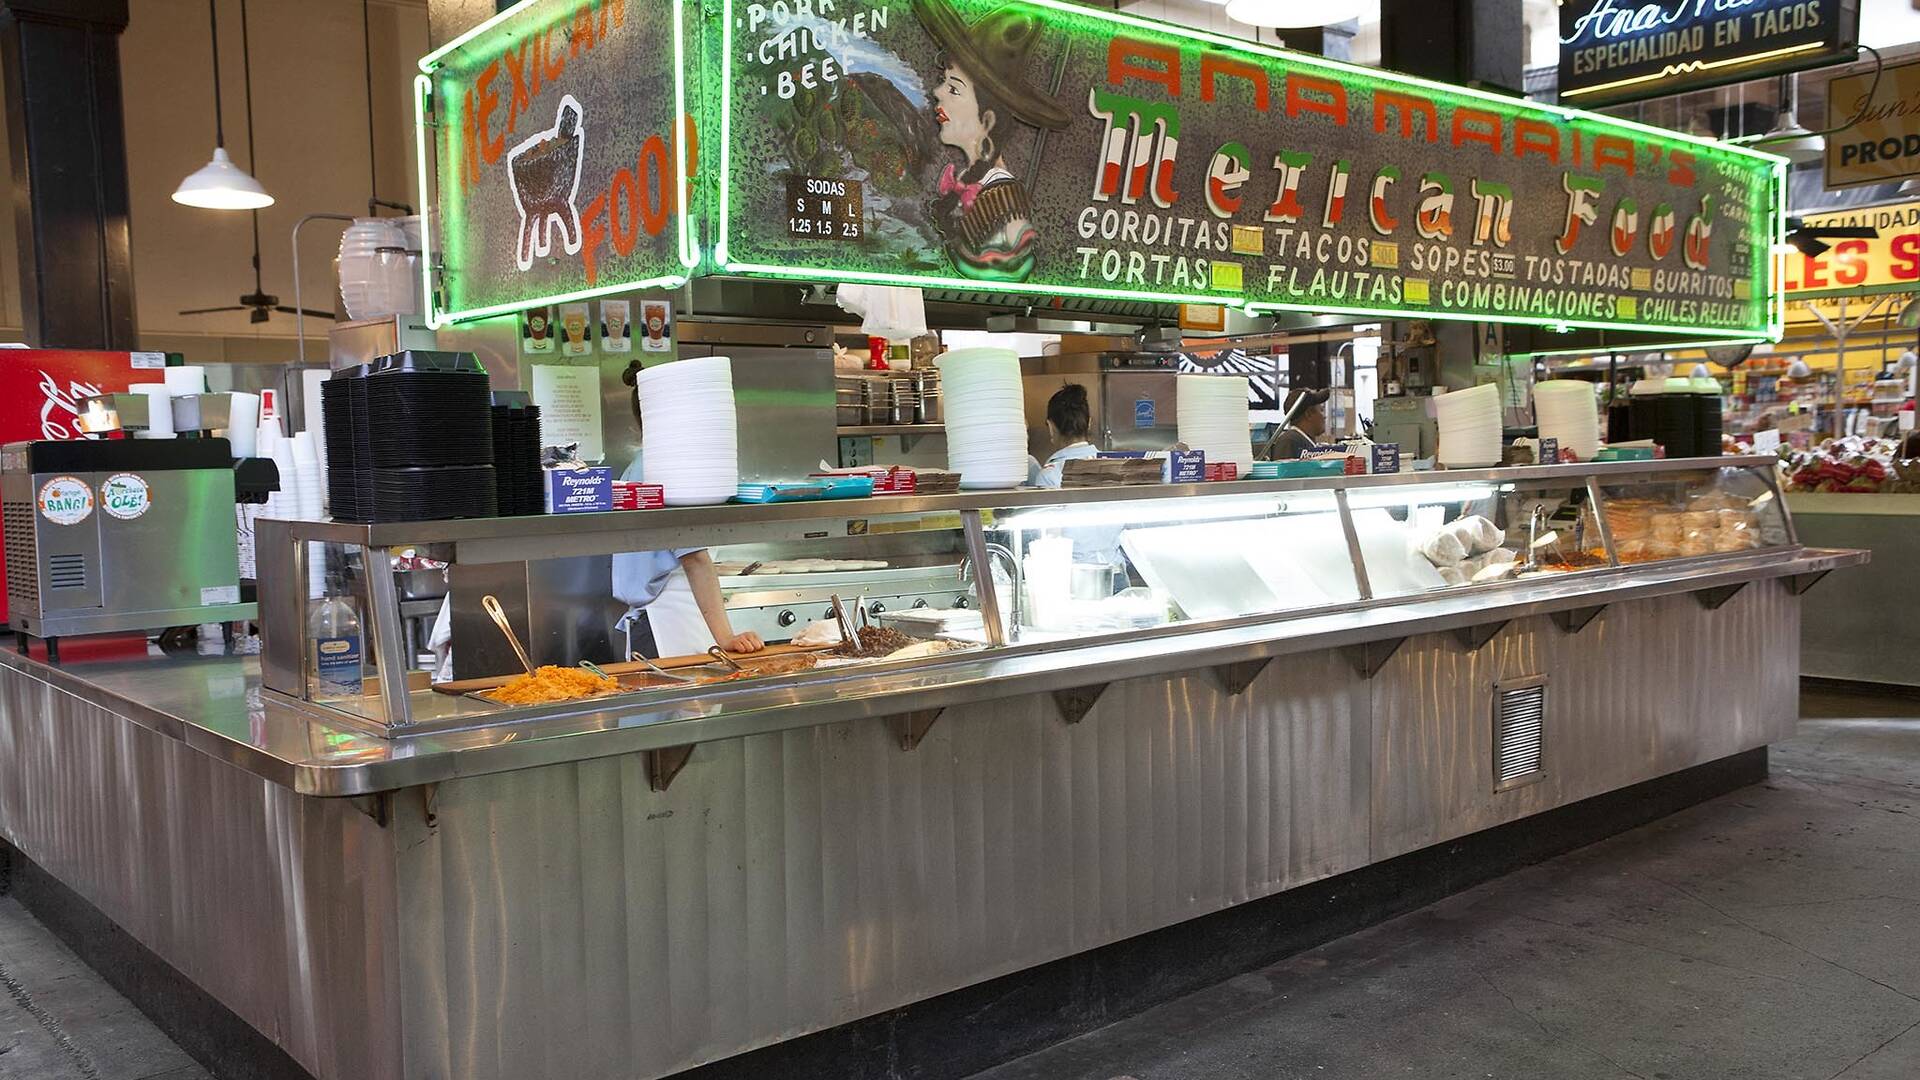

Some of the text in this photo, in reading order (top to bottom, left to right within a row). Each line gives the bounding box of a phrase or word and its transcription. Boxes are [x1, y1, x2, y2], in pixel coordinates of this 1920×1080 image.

[759, 6, 888, 65] CHICKEN
[1573, 26, 1704, 76] ESPECIALIDAD
[1714, 18, 1741, 48] EN
[778, 45, 854, 100] BEEF
[1107, 36, 1347, 127] ANA
[581, 112, 698, 286] FOOD
[797, 198, 855, 217] S M L
[807, 179, 845, 197] SODAS
[790, 217, 858, 237] 1.25 1.5 2.5
[1078, 206, 1229, 252] GORDITAS
[1275, 228, 1369, 267] TACOS
[1410, 242, 1491, 279] SOPES
[1555, 170, 1714, 270] Food
[1076, 247, 1208, 290] TORTAS
[1267, 264, 1402, 304] FLAUTAS
[1441, 279, 1617, 320] COMBINACIONES
[1642, 297, 1698, 325] CHILES
[1492, 258, 1514, 273] $3.00
[1525, 255, 1631, 290] TOSTADAS
[1653, 269, 1734, 299] BURRITOS
[562, 476, 602, 488] Reynolds
[565, 495, 597, 503] METRO
[572, 487, 595, 495] 721M
